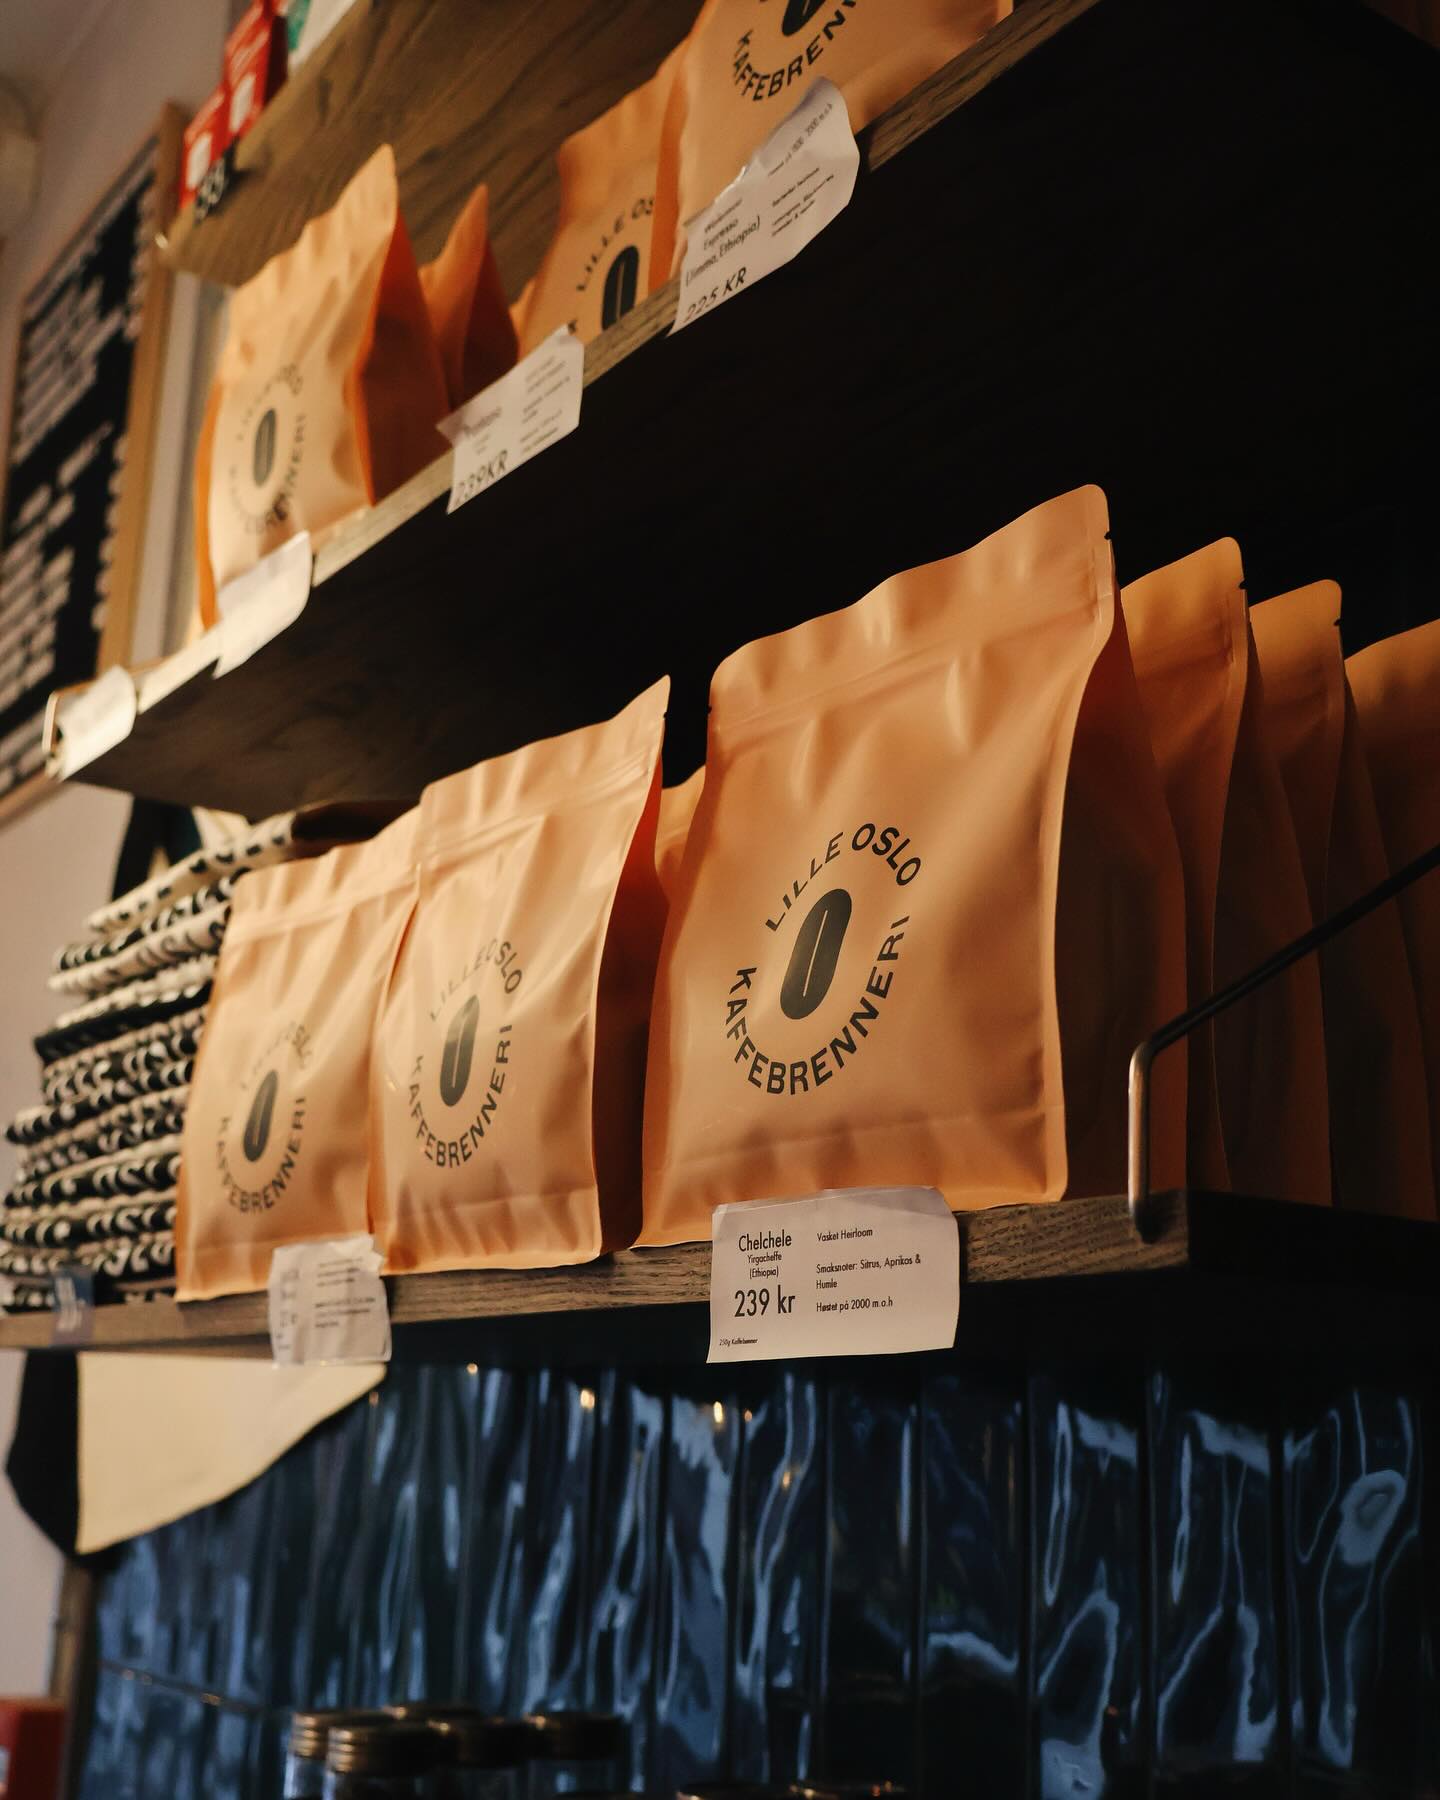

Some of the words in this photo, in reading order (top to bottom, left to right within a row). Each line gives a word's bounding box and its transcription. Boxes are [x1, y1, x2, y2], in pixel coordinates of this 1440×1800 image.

[722, 266, 748, 296] KR
[765, 831, 844, 932] LILLE
[851, 823, 922, 886] OSLO
[485, 938, 523, 995] OSLO
[726, 915, 910, 1096] KAFFEBRENNERI
[408, 1023, 513, 1169] KAFFEBRENNERI
[738, 1229, 792, 1252] Chelchele
[816, 1230, 839, 1242] Vasket
[840, 1228, 873, 1240] Heirloom
[747, 1251, 782, 1265] Yirgacheffe
[816, 1262, 858, 1274] Smaksnoter:
[860, 1259, 882, 1269] Sitrus,
[914, 1253, 922, 1264] &
[749, 1265, 779, 1279] (Ethiopia)
[816, 1278, 838, 1290] Humle
[734, 1288, 770, 1318] 239
[777, 1284, 796, 1314] kr
[839, 1300, 849, 1313] på
[850, 1298, 871, 1310] 2000
